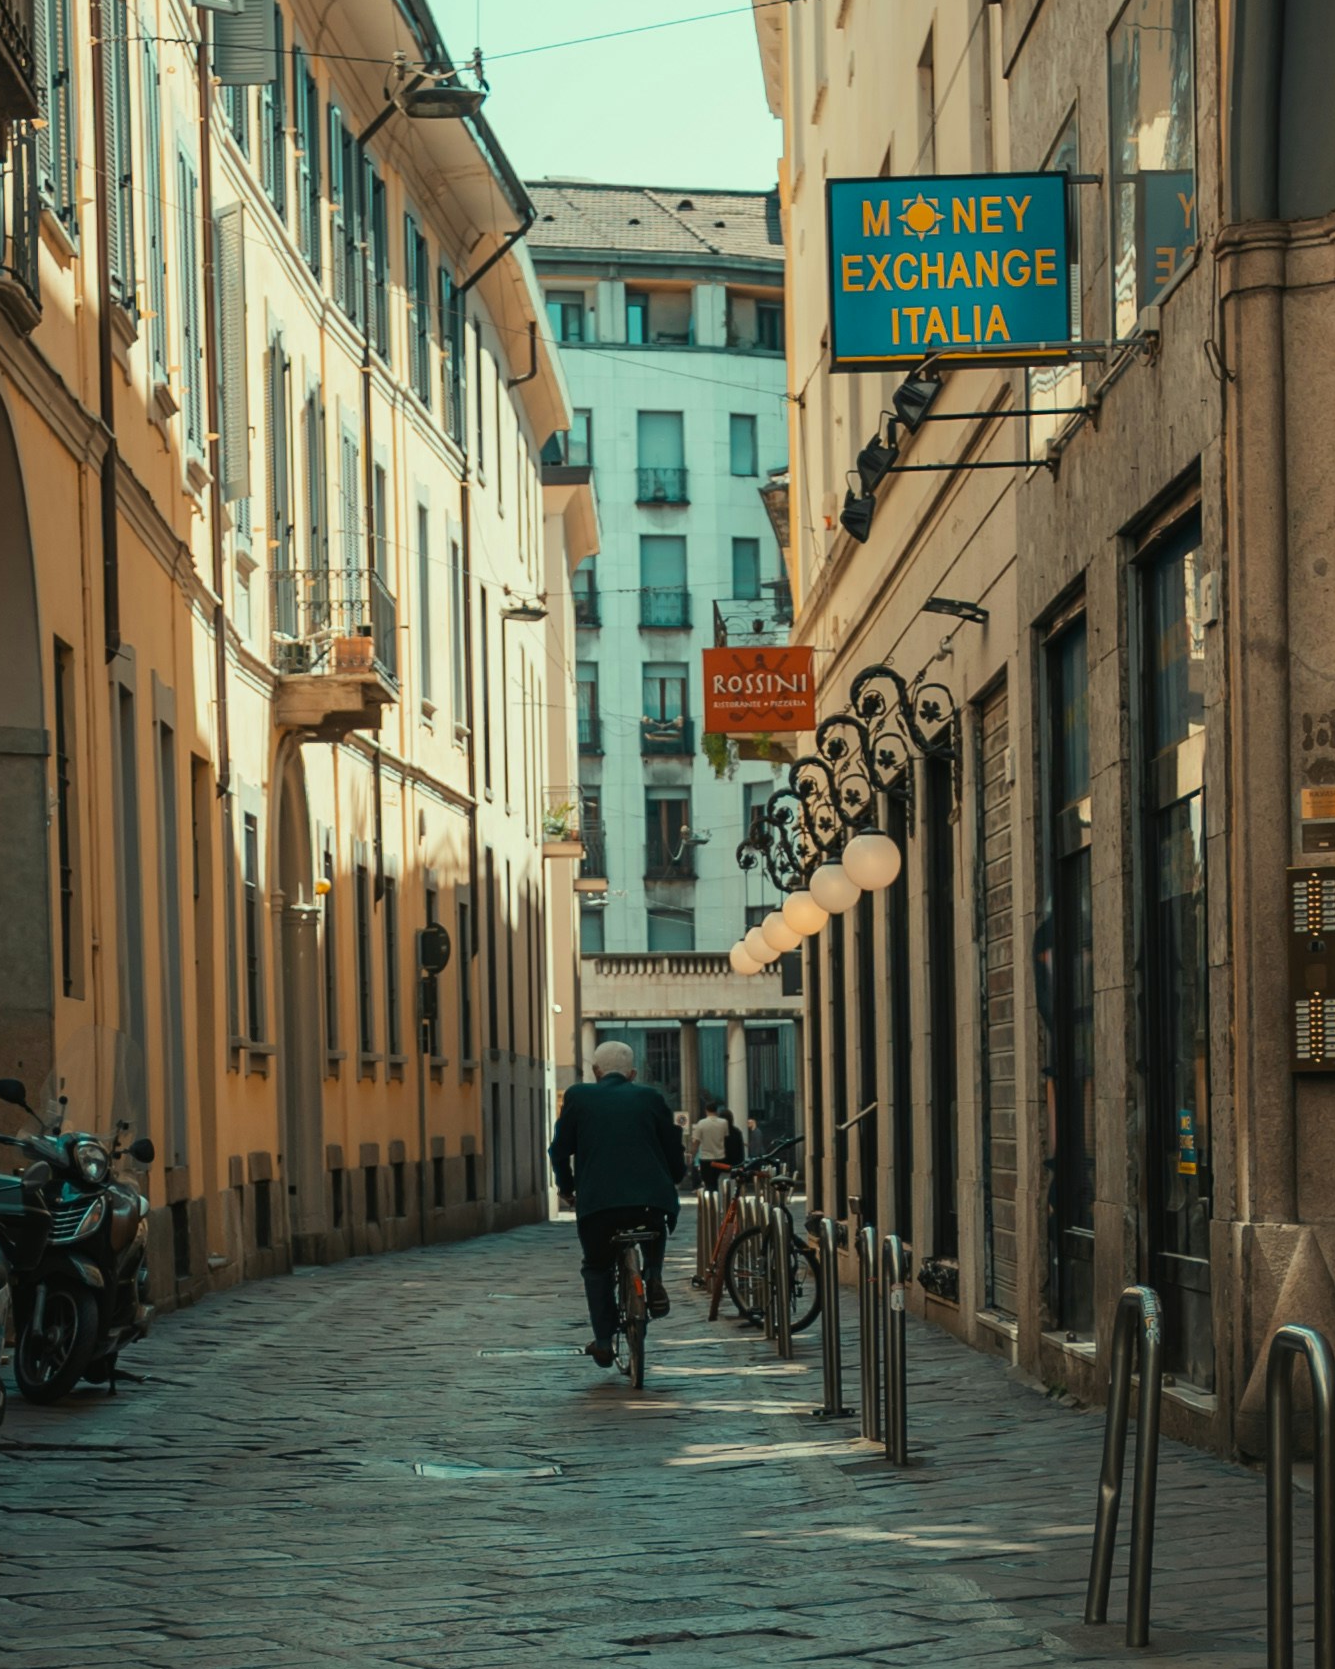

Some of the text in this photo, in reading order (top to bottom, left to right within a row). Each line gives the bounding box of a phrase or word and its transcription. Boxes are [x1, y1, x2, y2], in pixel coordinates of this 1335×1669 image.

[841, 247, 1059, 292] EXCHANGE
[890, 304, 1011, 345] ITALIA
[712, 673, 807, 694] ROSSINI
